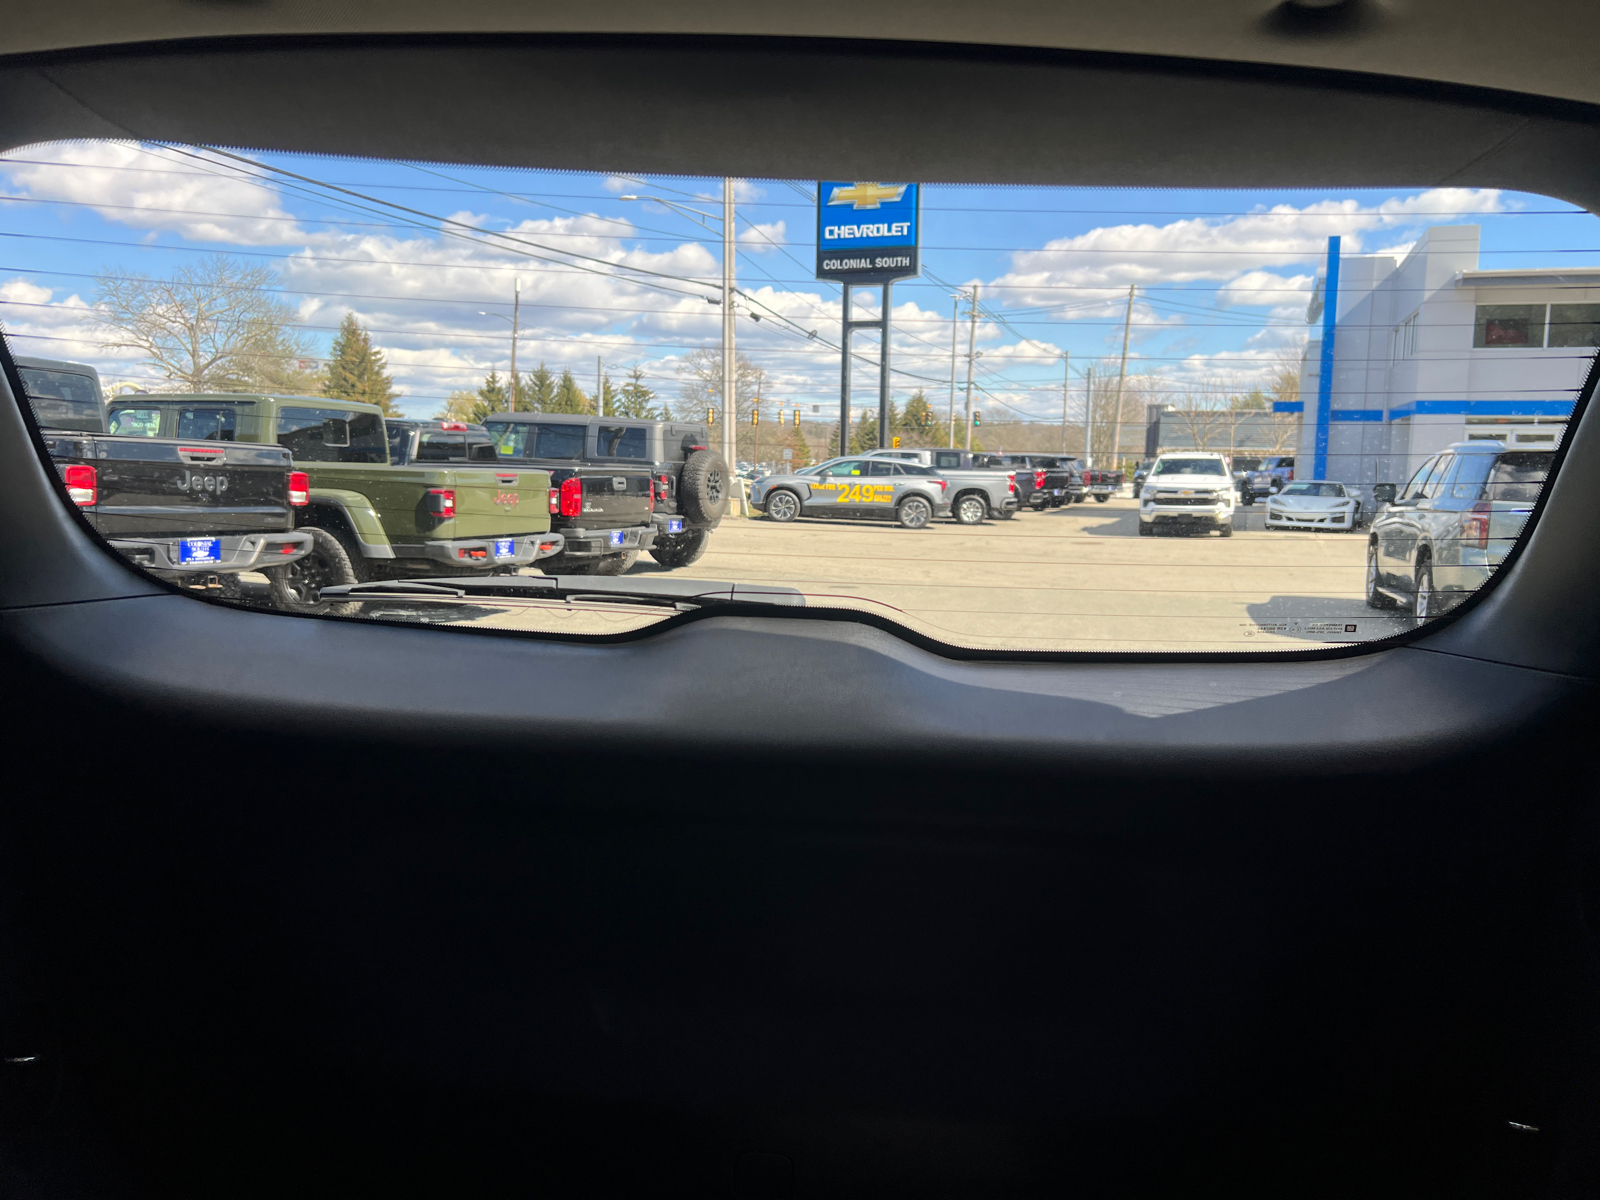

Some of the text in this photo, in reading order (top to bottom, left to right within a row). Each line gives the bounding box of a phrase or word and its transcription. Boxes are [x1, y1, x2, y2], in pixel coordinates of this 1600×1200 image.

[824, 222, 911, 239] CHEVROLET
[823, 256, 910, 270] COLONIAL SOUTH
[176, 470, 229, 495] Jeep
[493, 490, 520, 508] Jeep
